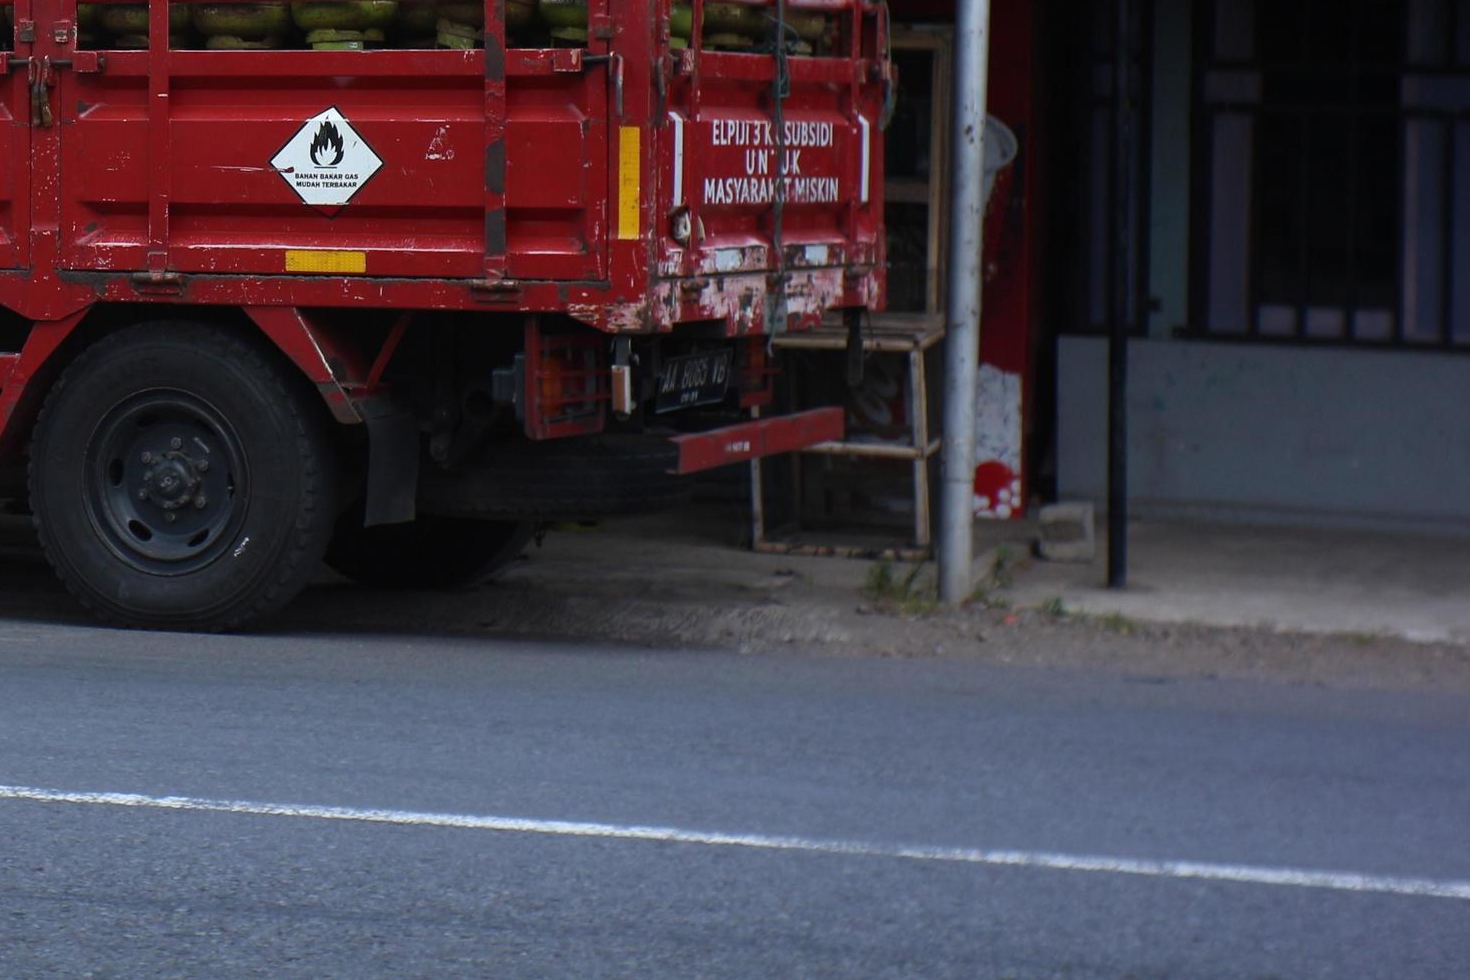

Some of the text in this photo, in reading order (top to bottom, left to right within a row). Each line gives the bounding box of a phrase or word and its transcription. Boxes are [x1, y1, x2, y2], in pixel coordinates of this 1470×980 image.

[713, 119, 750, 146] ELPIJI
[753, 120, 761, 146] 3
[784, 121, 834, 147] SUBSIDI
[746, 149, 801, 175] UNUK
[794, 177, 839, 203] MISKIN
